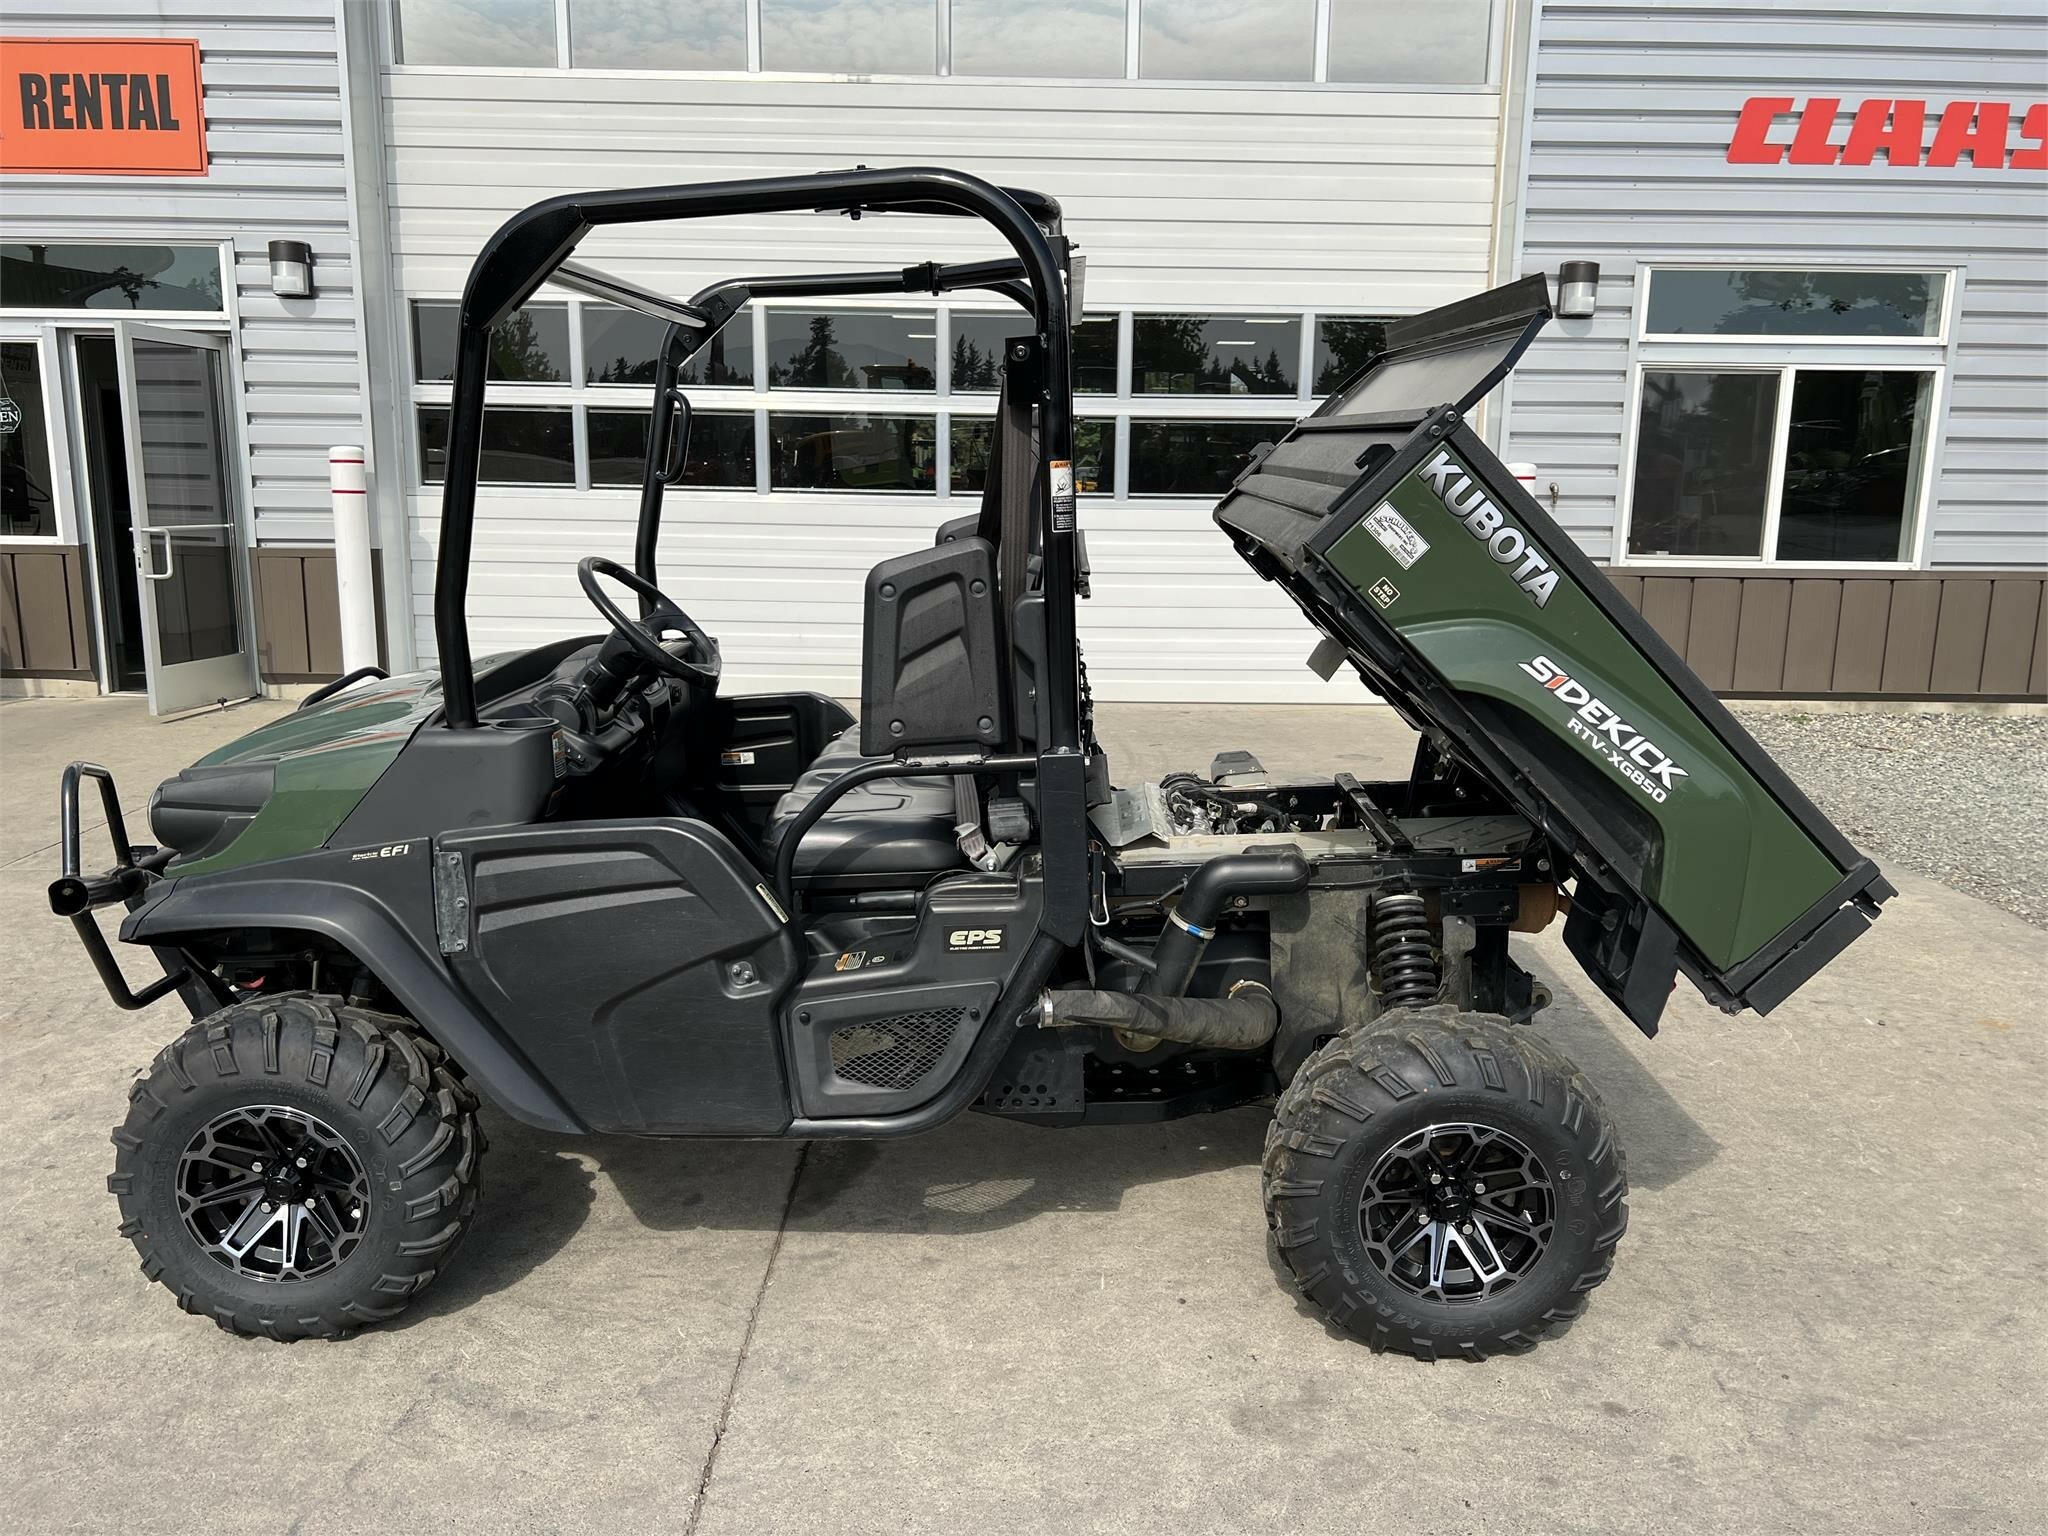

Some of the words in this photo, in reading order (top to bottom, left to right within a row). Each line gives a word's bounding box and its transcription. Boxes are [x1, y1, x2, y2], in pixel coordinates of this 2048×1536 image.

[19, 73, 180, 131] RENTAL
[1726, 96, 2048, 170] CLAAS
[1418, 450, 1561, 610] KUBOTA
[1373, 586, 1391, 603] STEP
[1382, 584, 1393, 596] NO
[1517, 655, 1690, 791] SIDEKICK
[1566, 717, 1668, 804] RTV-XG850
[380, 844, 409, 857] EFI
[950, 929, 1002, 945] EPS
